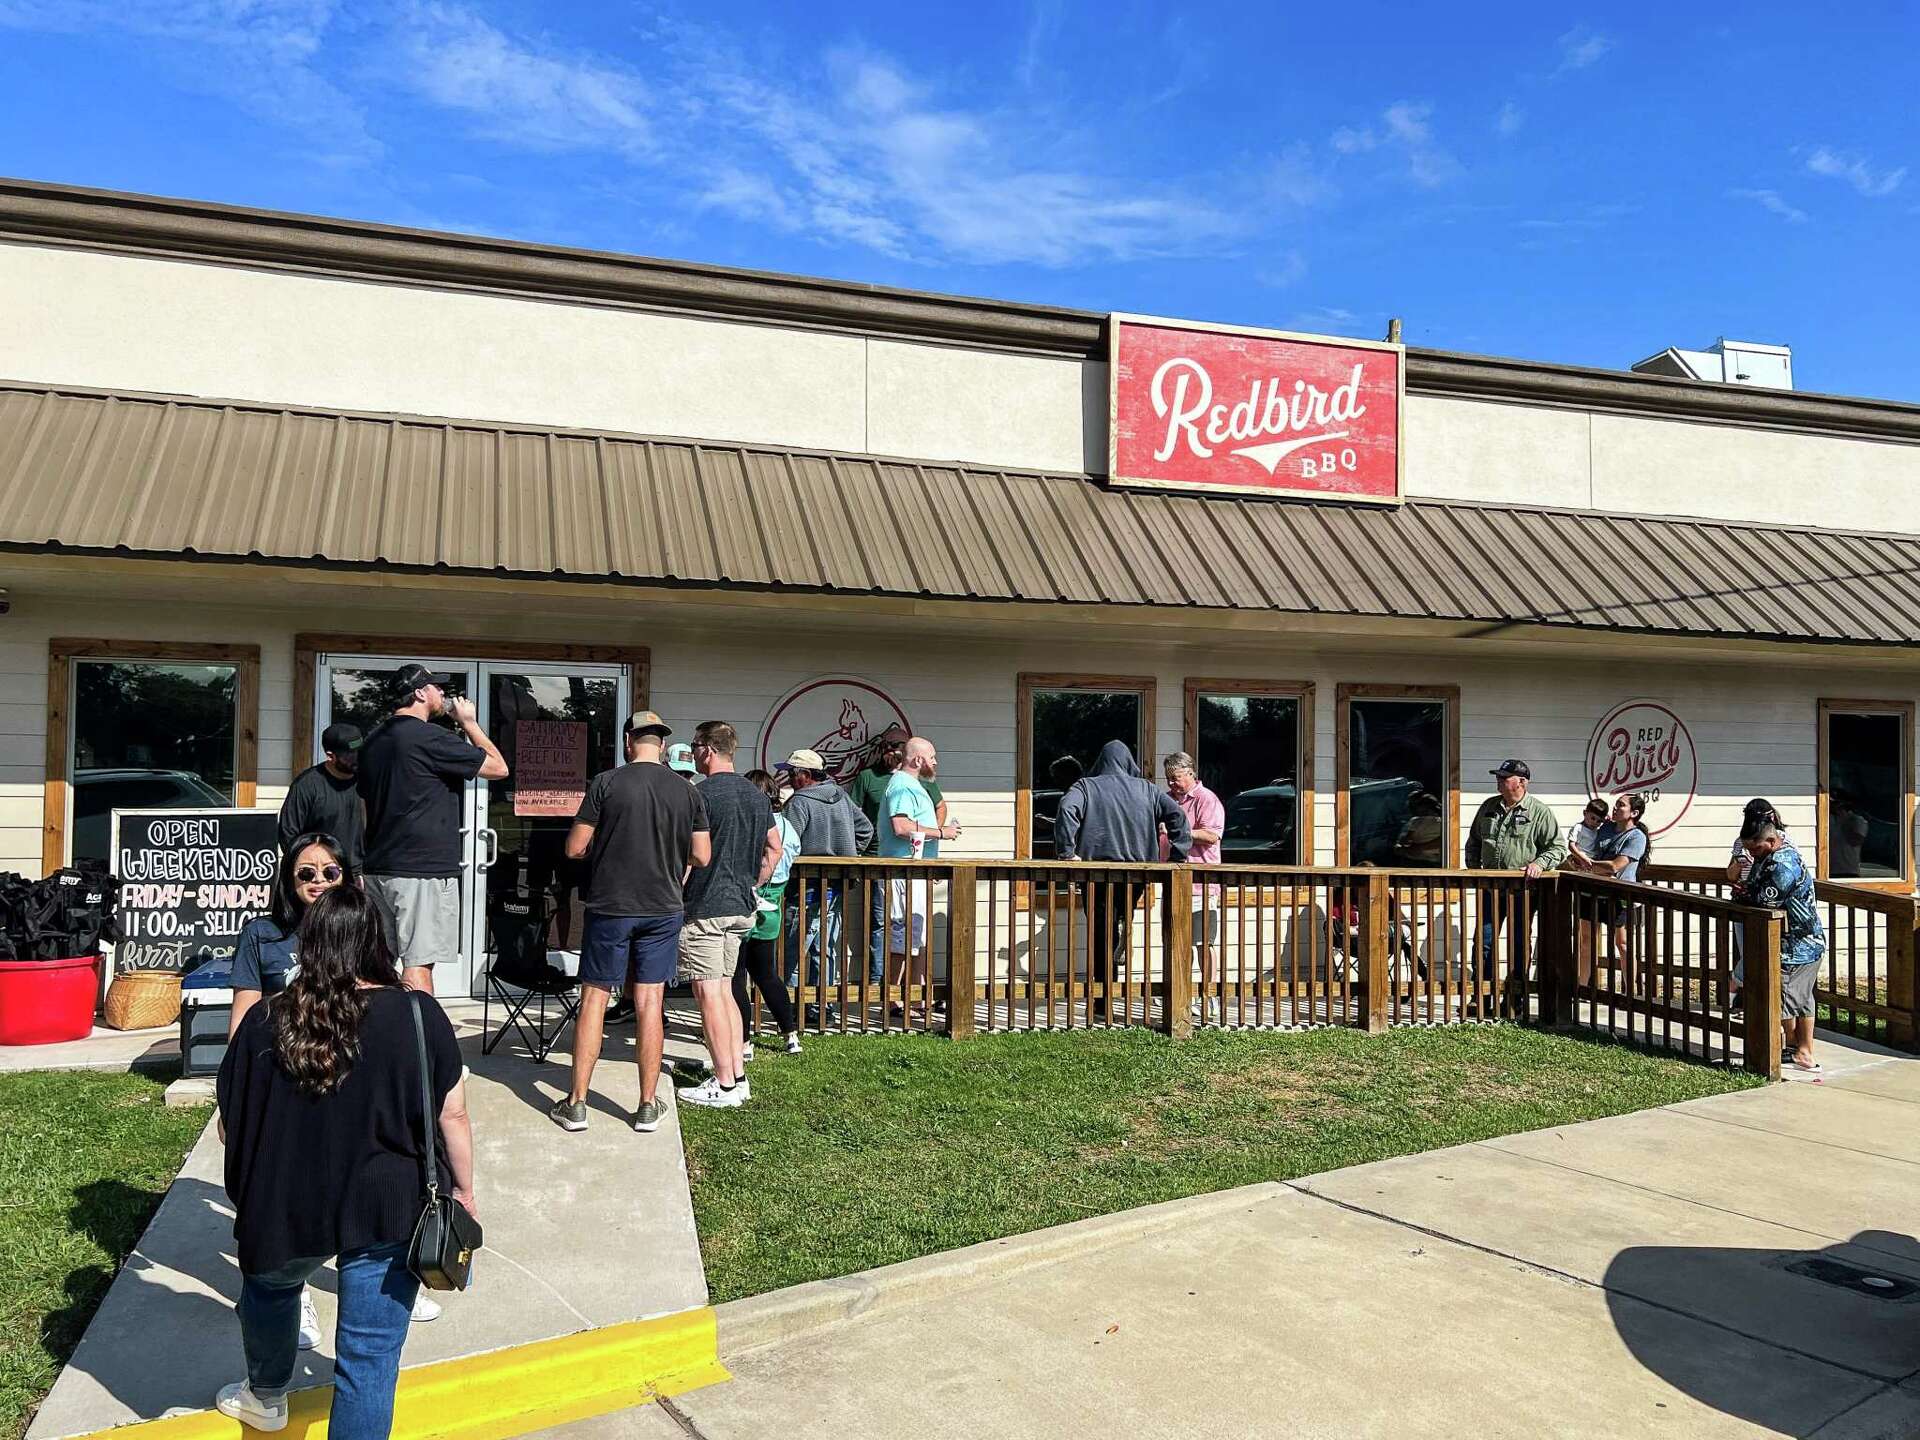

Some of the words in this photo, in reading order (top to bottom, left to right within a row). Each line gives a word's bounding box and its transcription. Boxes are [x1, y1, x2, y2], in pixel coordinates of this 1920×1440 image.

[1151, 357, 1366, 463] Redbird
[1301, 448, 1357, 478] BBQ
[1638, 727, 1663, 742] RED
[521, 749, 548, 764] BEEF
[1596, 722, 1680, 788] Bird
[1640, 788, 1660, 803] BQ
[148, 819, 220, 846] OPEN
[121, 848, 277, 882] WEEKENDS
[120, 940, 192, 973] first
